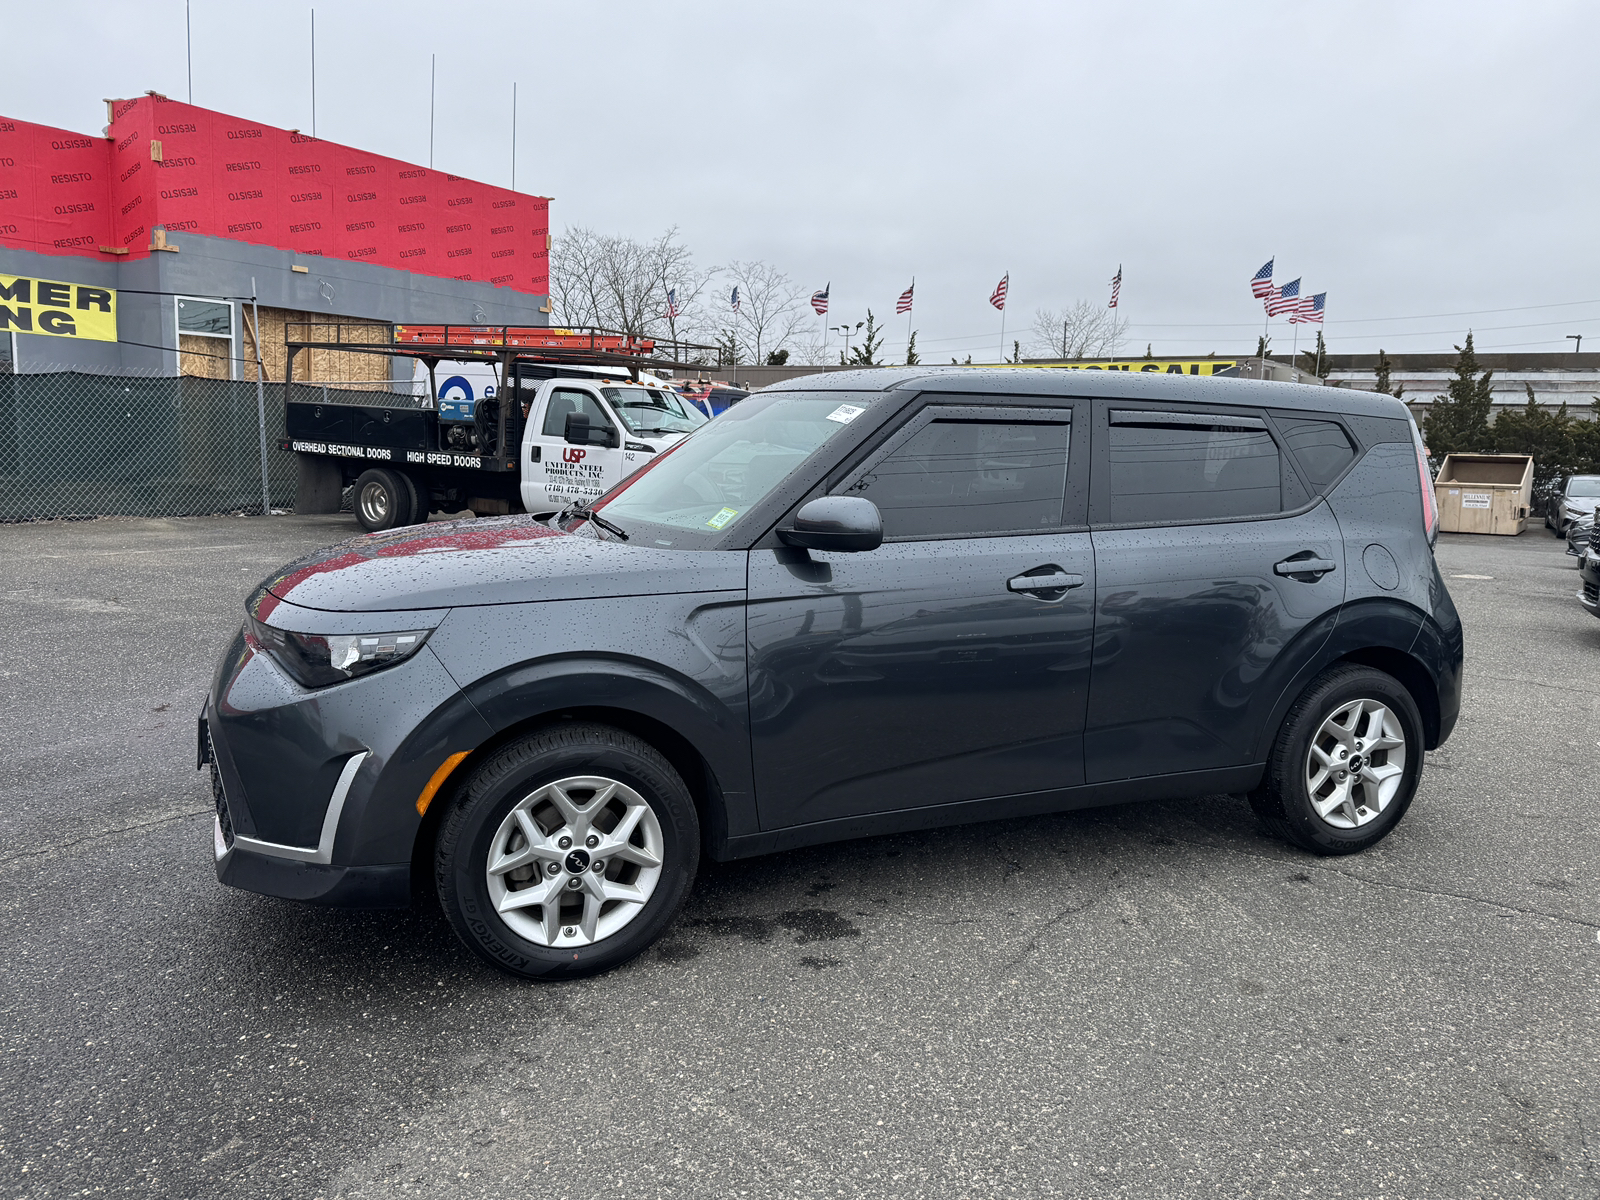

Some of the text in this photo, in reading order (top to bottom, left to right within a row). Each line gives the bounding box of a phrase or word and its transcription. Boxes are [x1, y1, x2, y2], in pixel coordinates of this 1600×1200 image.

[116, 98, 138, 118] RESISTO
[158, 124, 196, 135] RESISTO
[227, 129, 262, 139] RESISTO
[51, 139, 92, 150] RESISTO
[118, 131, 138, 152] RESISTO
[120, 161, 142, 182] RESISTO
[226, 161, 261, 172] RESISTO
[288, 164, 321, 175] RESISTO
[346, 165, 376, 176] RESISTO
[51, 172, 92, 184] RESISTO
[398, 170, 426, 179] RESISTO
[161, 187, 198, 199] RESISTO
[228, 190, 263, 201] RESISTO
[290, 192, 322, 203] RESISTO
[347, 192, 377, 203] RESISTO
[121, 195, 142, 215] RESISTO
[400, 195, 427, 205] RESISTO
[448, 197, 473, 207] RESISTO
[492, 200, 515, 209] RESISTO
[54, 203, 95, 215] RESISTO
[228, 221, 262, 233] RESISTO
[289, 222, 321, 233] RESISTO
[345, 221, 375, 232] RESISTO
[398, 222, 425, 233] RESISTO
[446, 223, 472, 233] RESISTO
[491, 225, 514, 235] RESISTO
[124, 225, 145, 245] RESISTO
[53, 236, 94, 248] RESISTO
[347, 246, 377, 258] RESISTO
[400, 247, 426, 259] RESISTO
[448, 247, 472, 258] RESISTO
[492, 250, 515, 259] RESISTO
[491, 273, 514, 284] RESISTO
[292, 441, 391, 460] OVERHEAD SECTIONAL DOORS
[406, 451, 481, 469] HIGH SPEED DOORS
[545, 461, 604, 472] UNITED STEEL
[589, 471, 604, 480] INC.
[544, 484, 604, 496] (718) 478-5330
